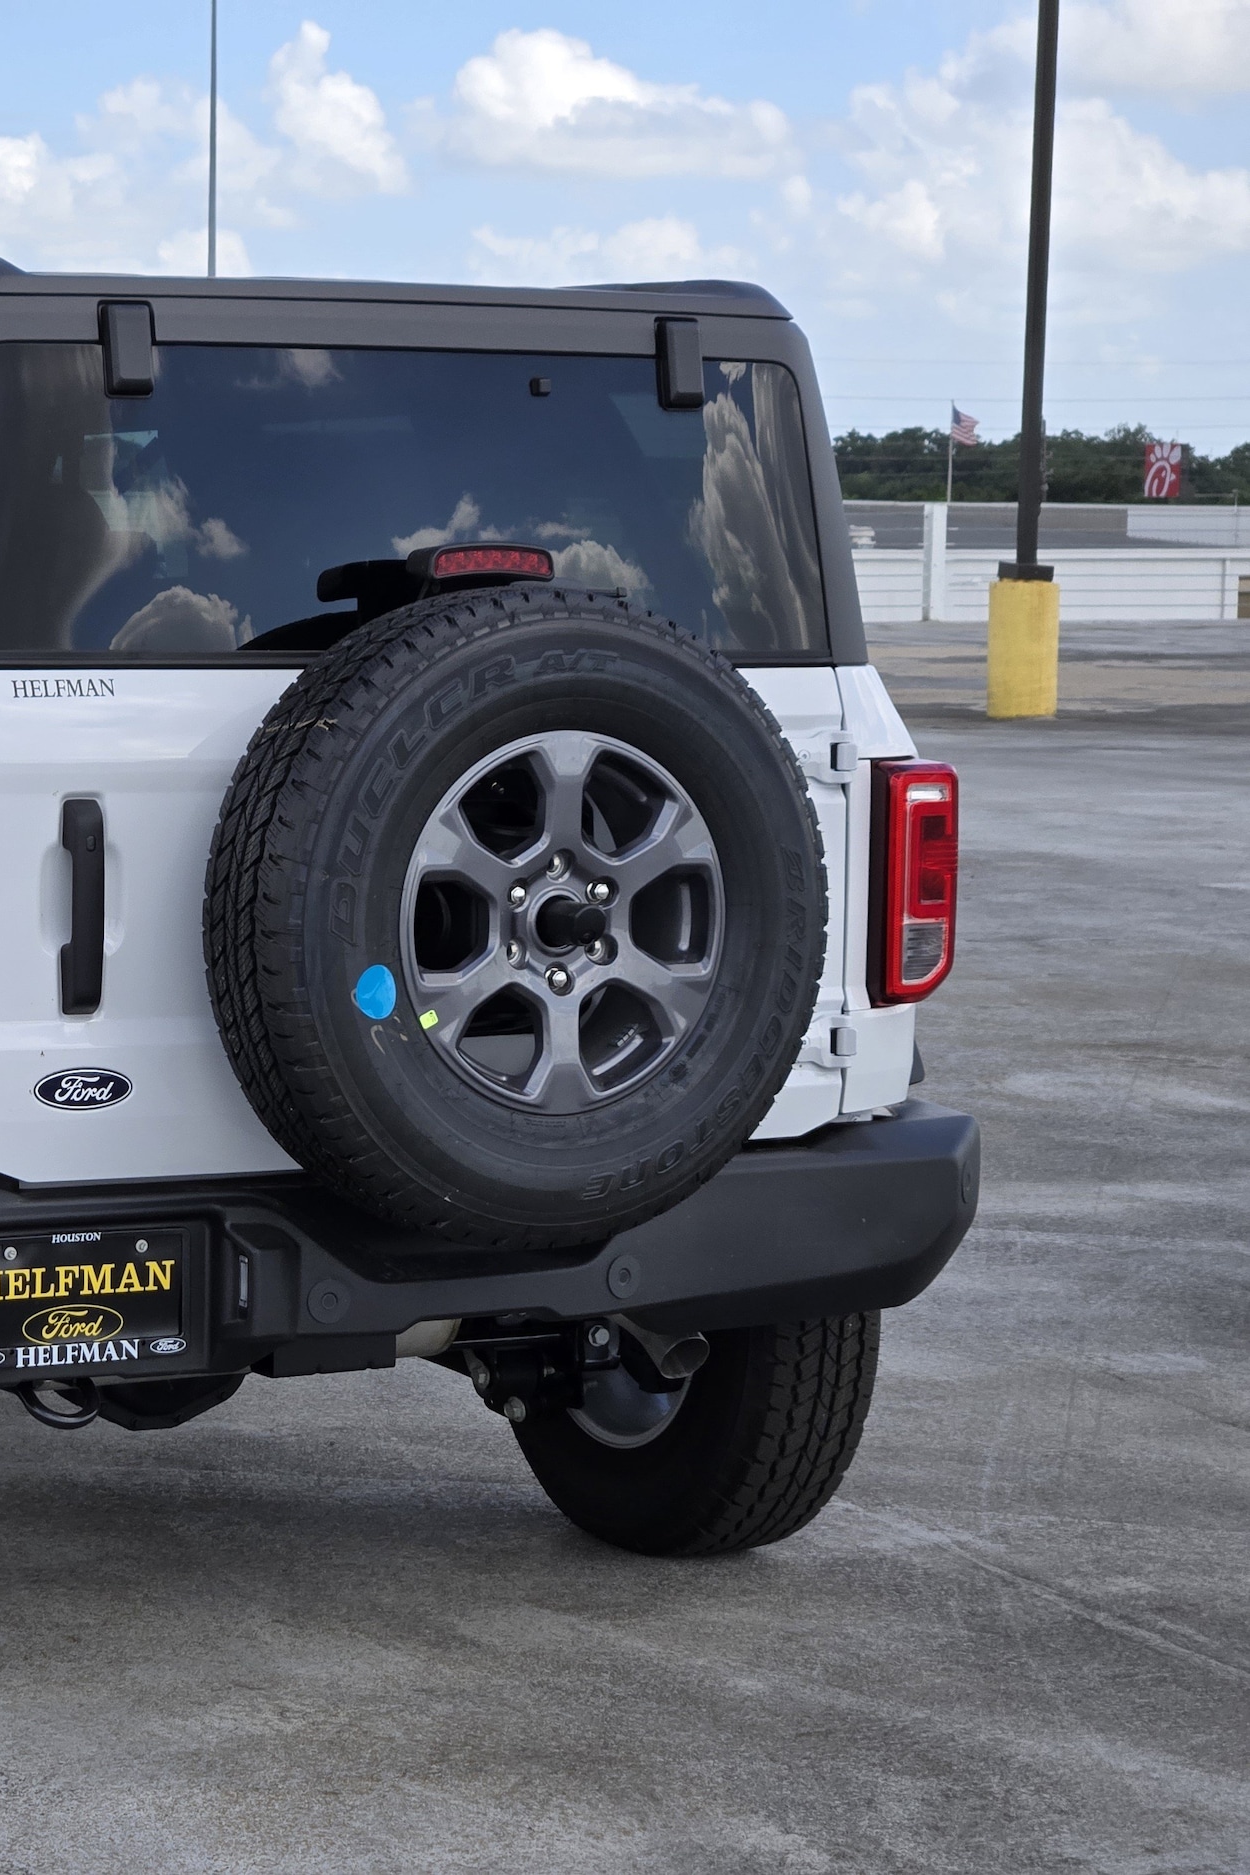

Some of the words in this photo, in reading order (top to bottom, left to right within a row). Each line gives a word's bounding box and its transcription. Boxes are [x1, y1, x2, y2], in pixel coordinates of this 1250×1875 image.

[11, 678, 115, 698] HELFMAN
[328, 654, 516, 948] DUELER
[533, 648, 620, 674] A/T
[581, 845, 807, 1201] BRIDGESTONE
[54, 1075, 114, 1102] Ford
[51, 1231, 102, 1244] HOUSTON
[41, 1309, 104, 1340] Ford
[15, 1338, 141, 1369] HELFMAN
[155, 1339, 181, 1352] Ford
